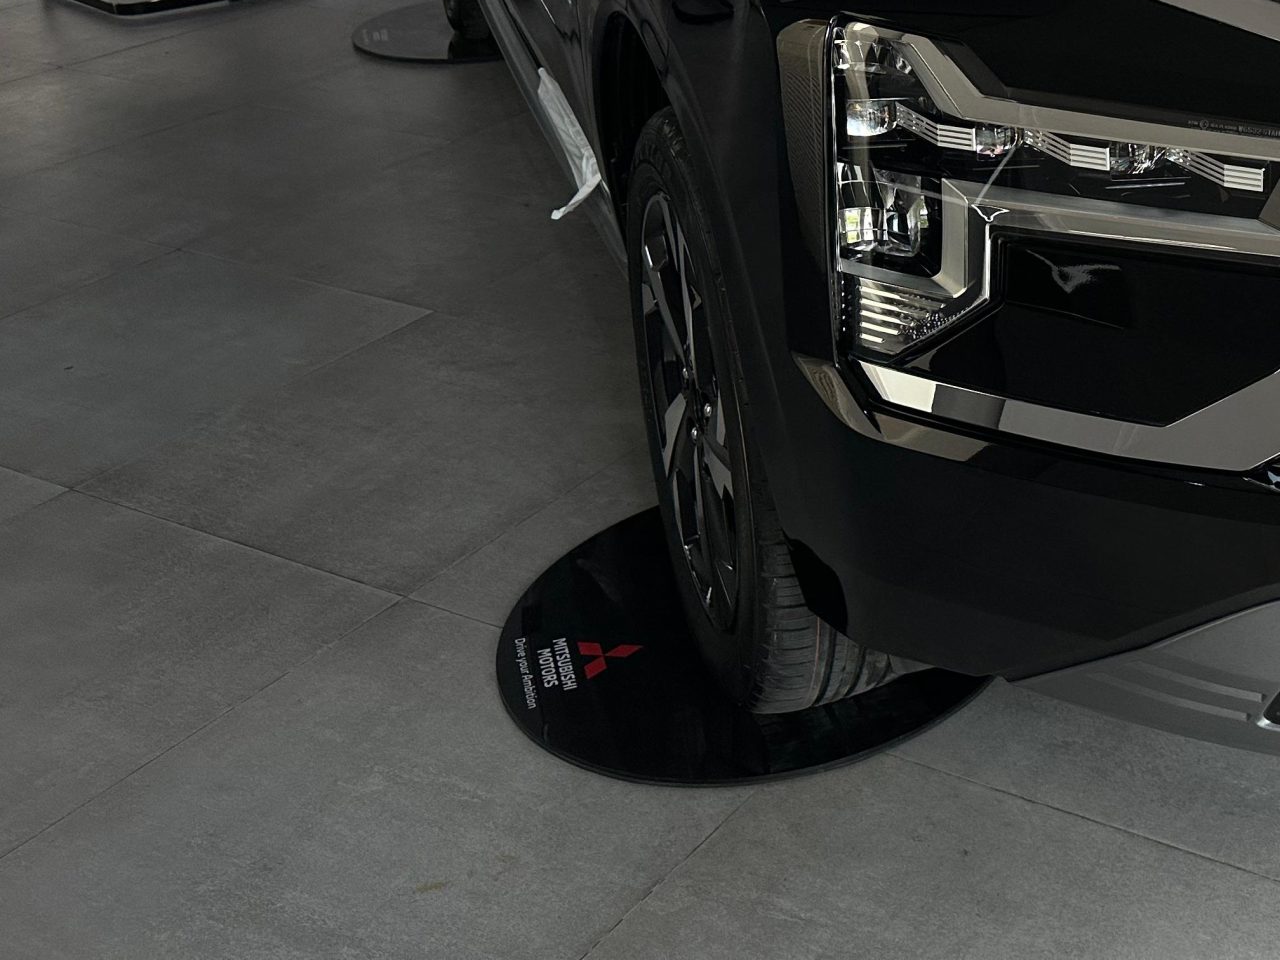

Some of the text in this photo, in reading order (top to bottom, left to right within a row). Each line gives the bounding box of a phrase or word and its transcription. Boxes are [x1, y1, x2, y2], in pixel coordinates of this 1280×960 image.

[515, 638, 538, 709] Drive your Ambition
[537, 648, 558, 688] MOTORS
[552, 637, 578, 690] MITSUBISHI
